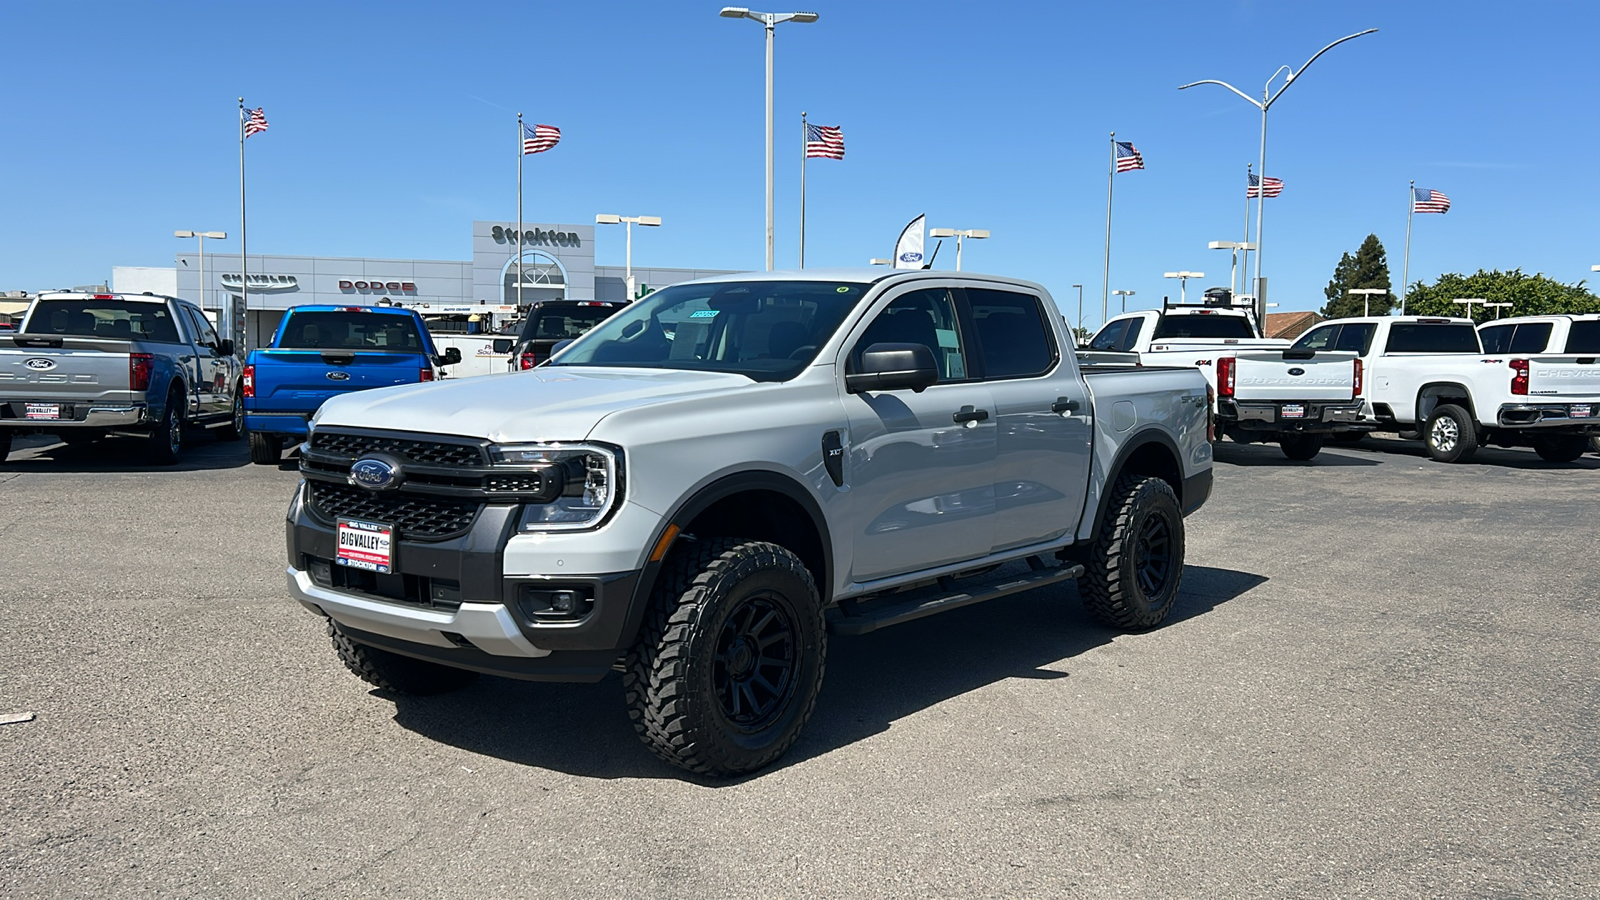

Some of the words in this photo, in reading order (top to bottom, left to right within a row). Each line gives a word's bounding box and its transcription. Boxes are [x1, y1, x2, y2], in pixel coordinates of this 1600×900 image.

[491, 225, 580, 245] Stockton
[222, 273, 297, 284] CHRYSLER
[339, 280, 416, 291] DODGE
[358, 465, 383, 482] Ford
[359, 523, 378, 531] VALLEY
[341, 531, 380, 550] BIGVALLEY
[347, 558, 377, 571] STOCKTON
